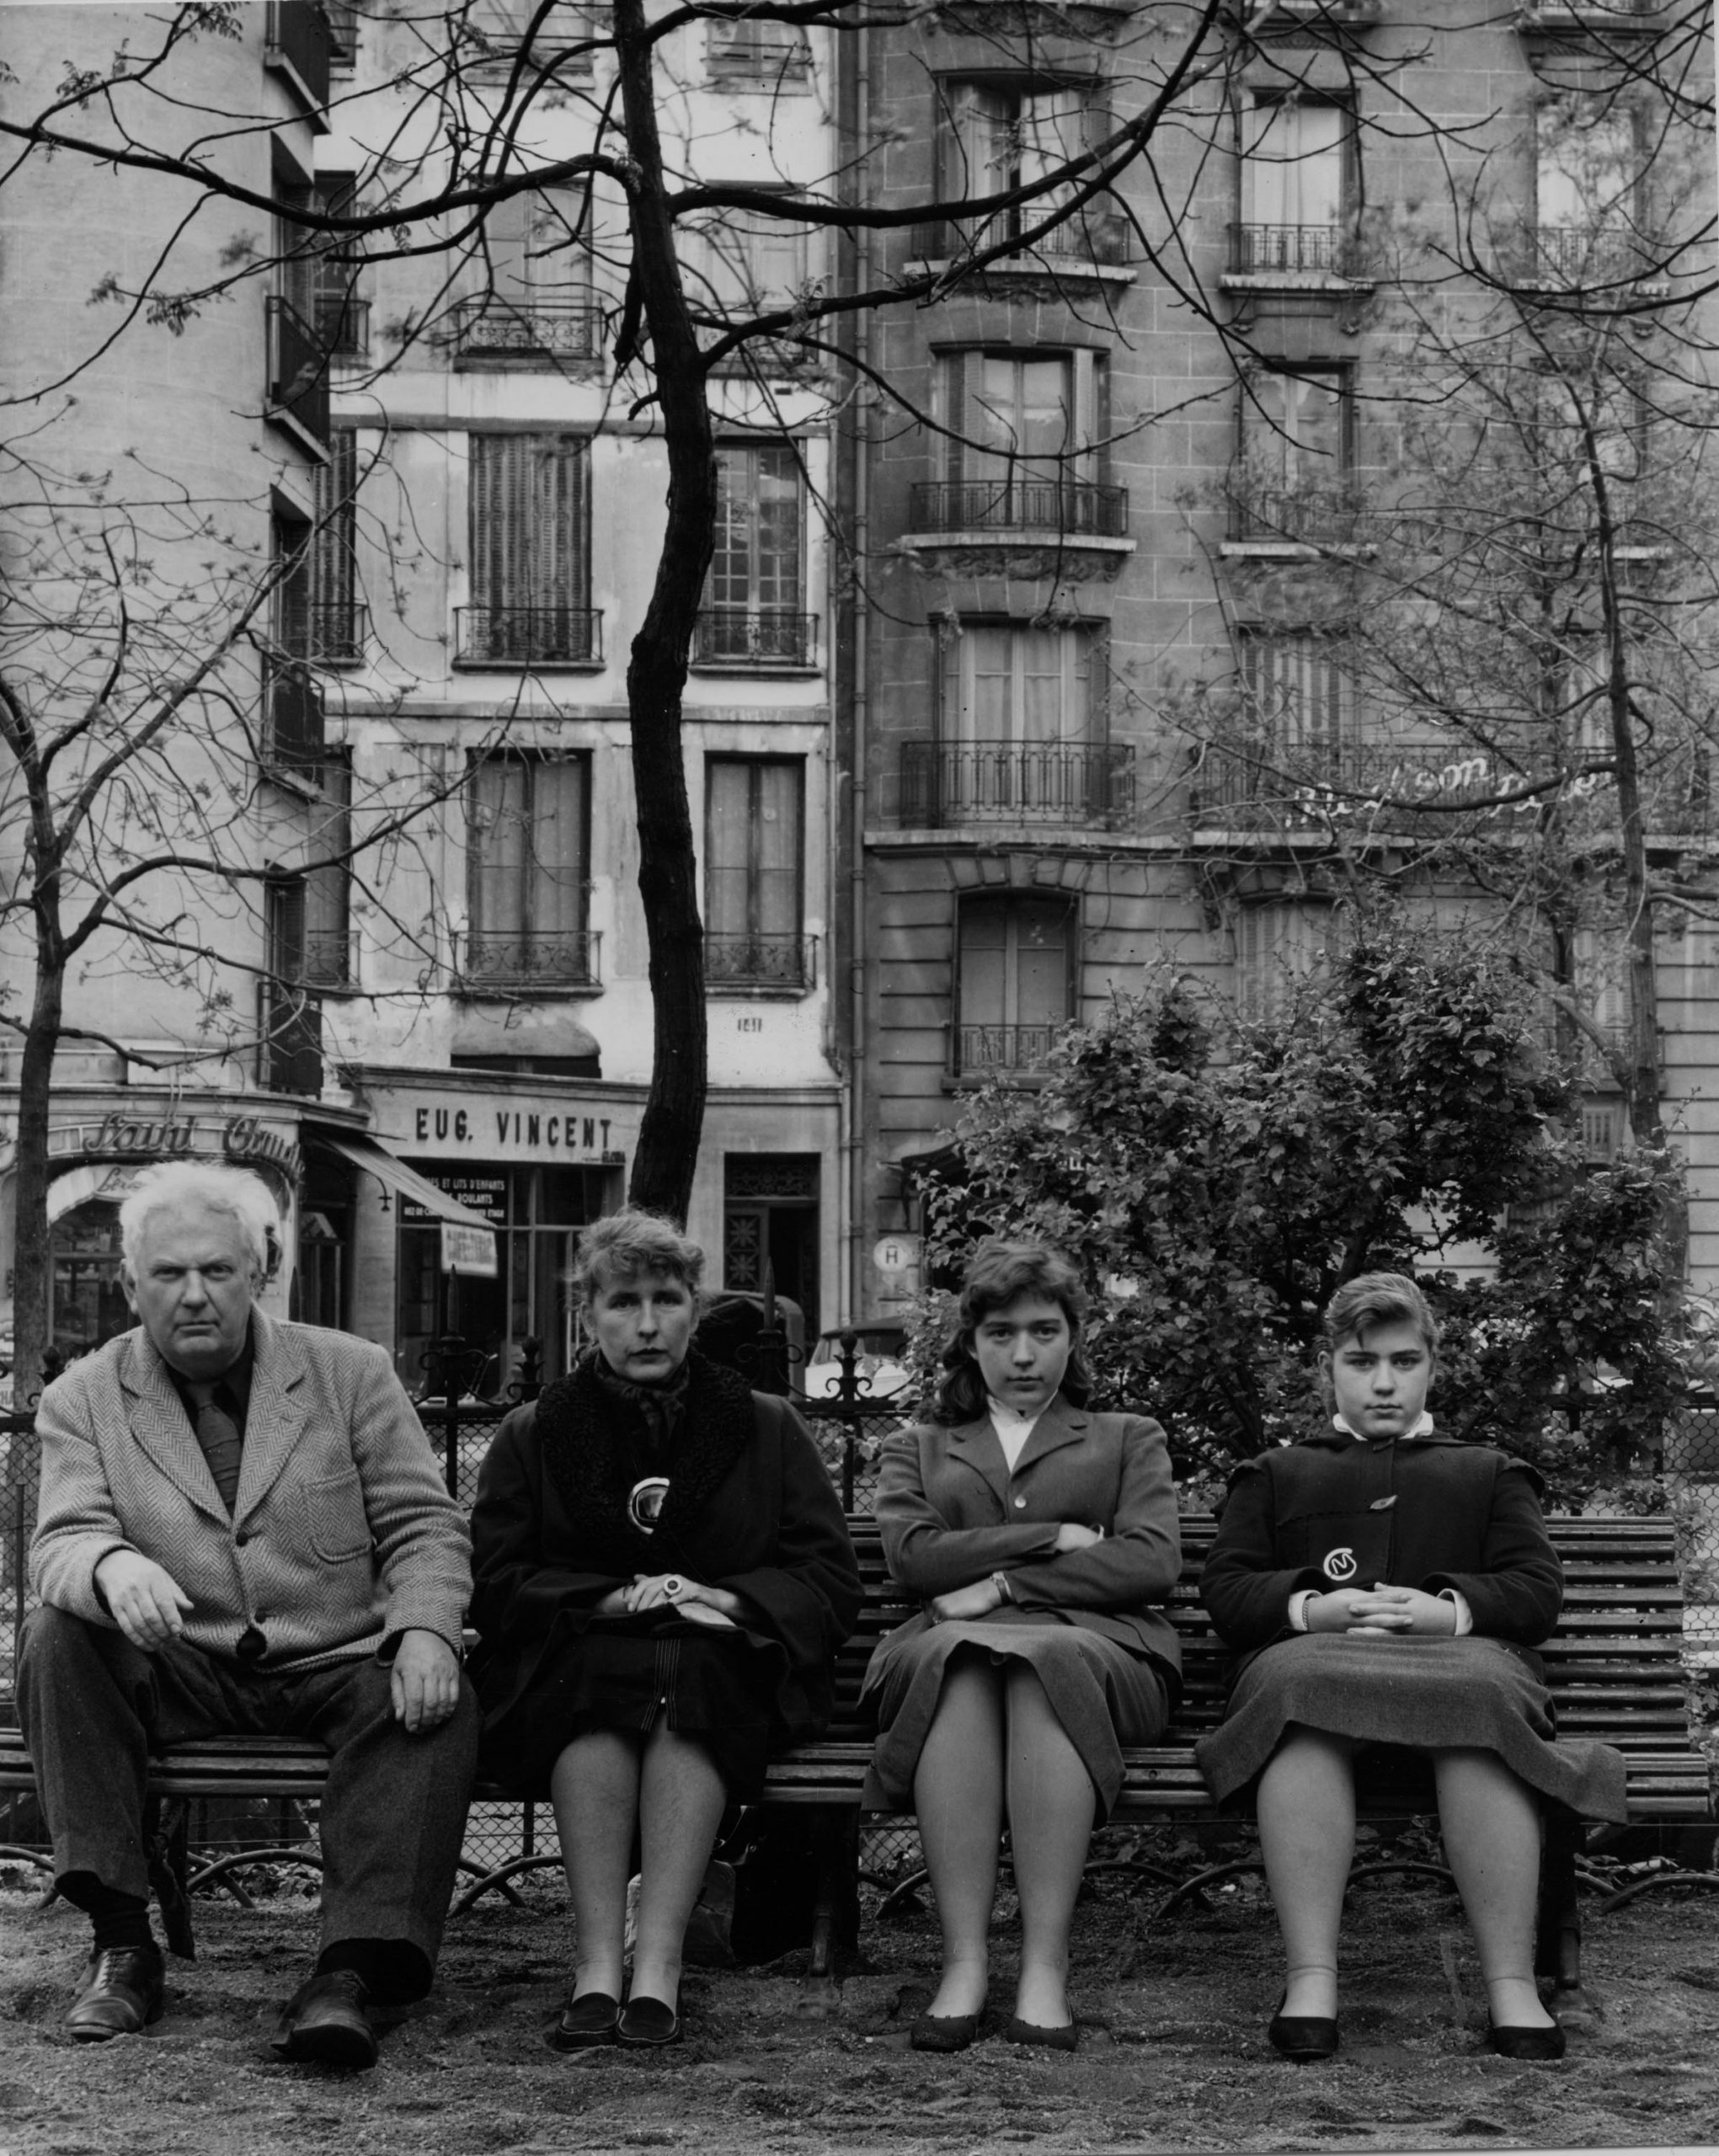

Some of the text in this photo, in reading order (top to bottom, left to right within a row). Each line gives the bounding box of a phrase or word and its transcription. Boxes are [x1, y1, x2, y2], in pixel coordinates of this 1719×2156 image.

[416, 1108, 611, 1150] EUG. VINCENT
[442, 1177, 451, 1188] ET
